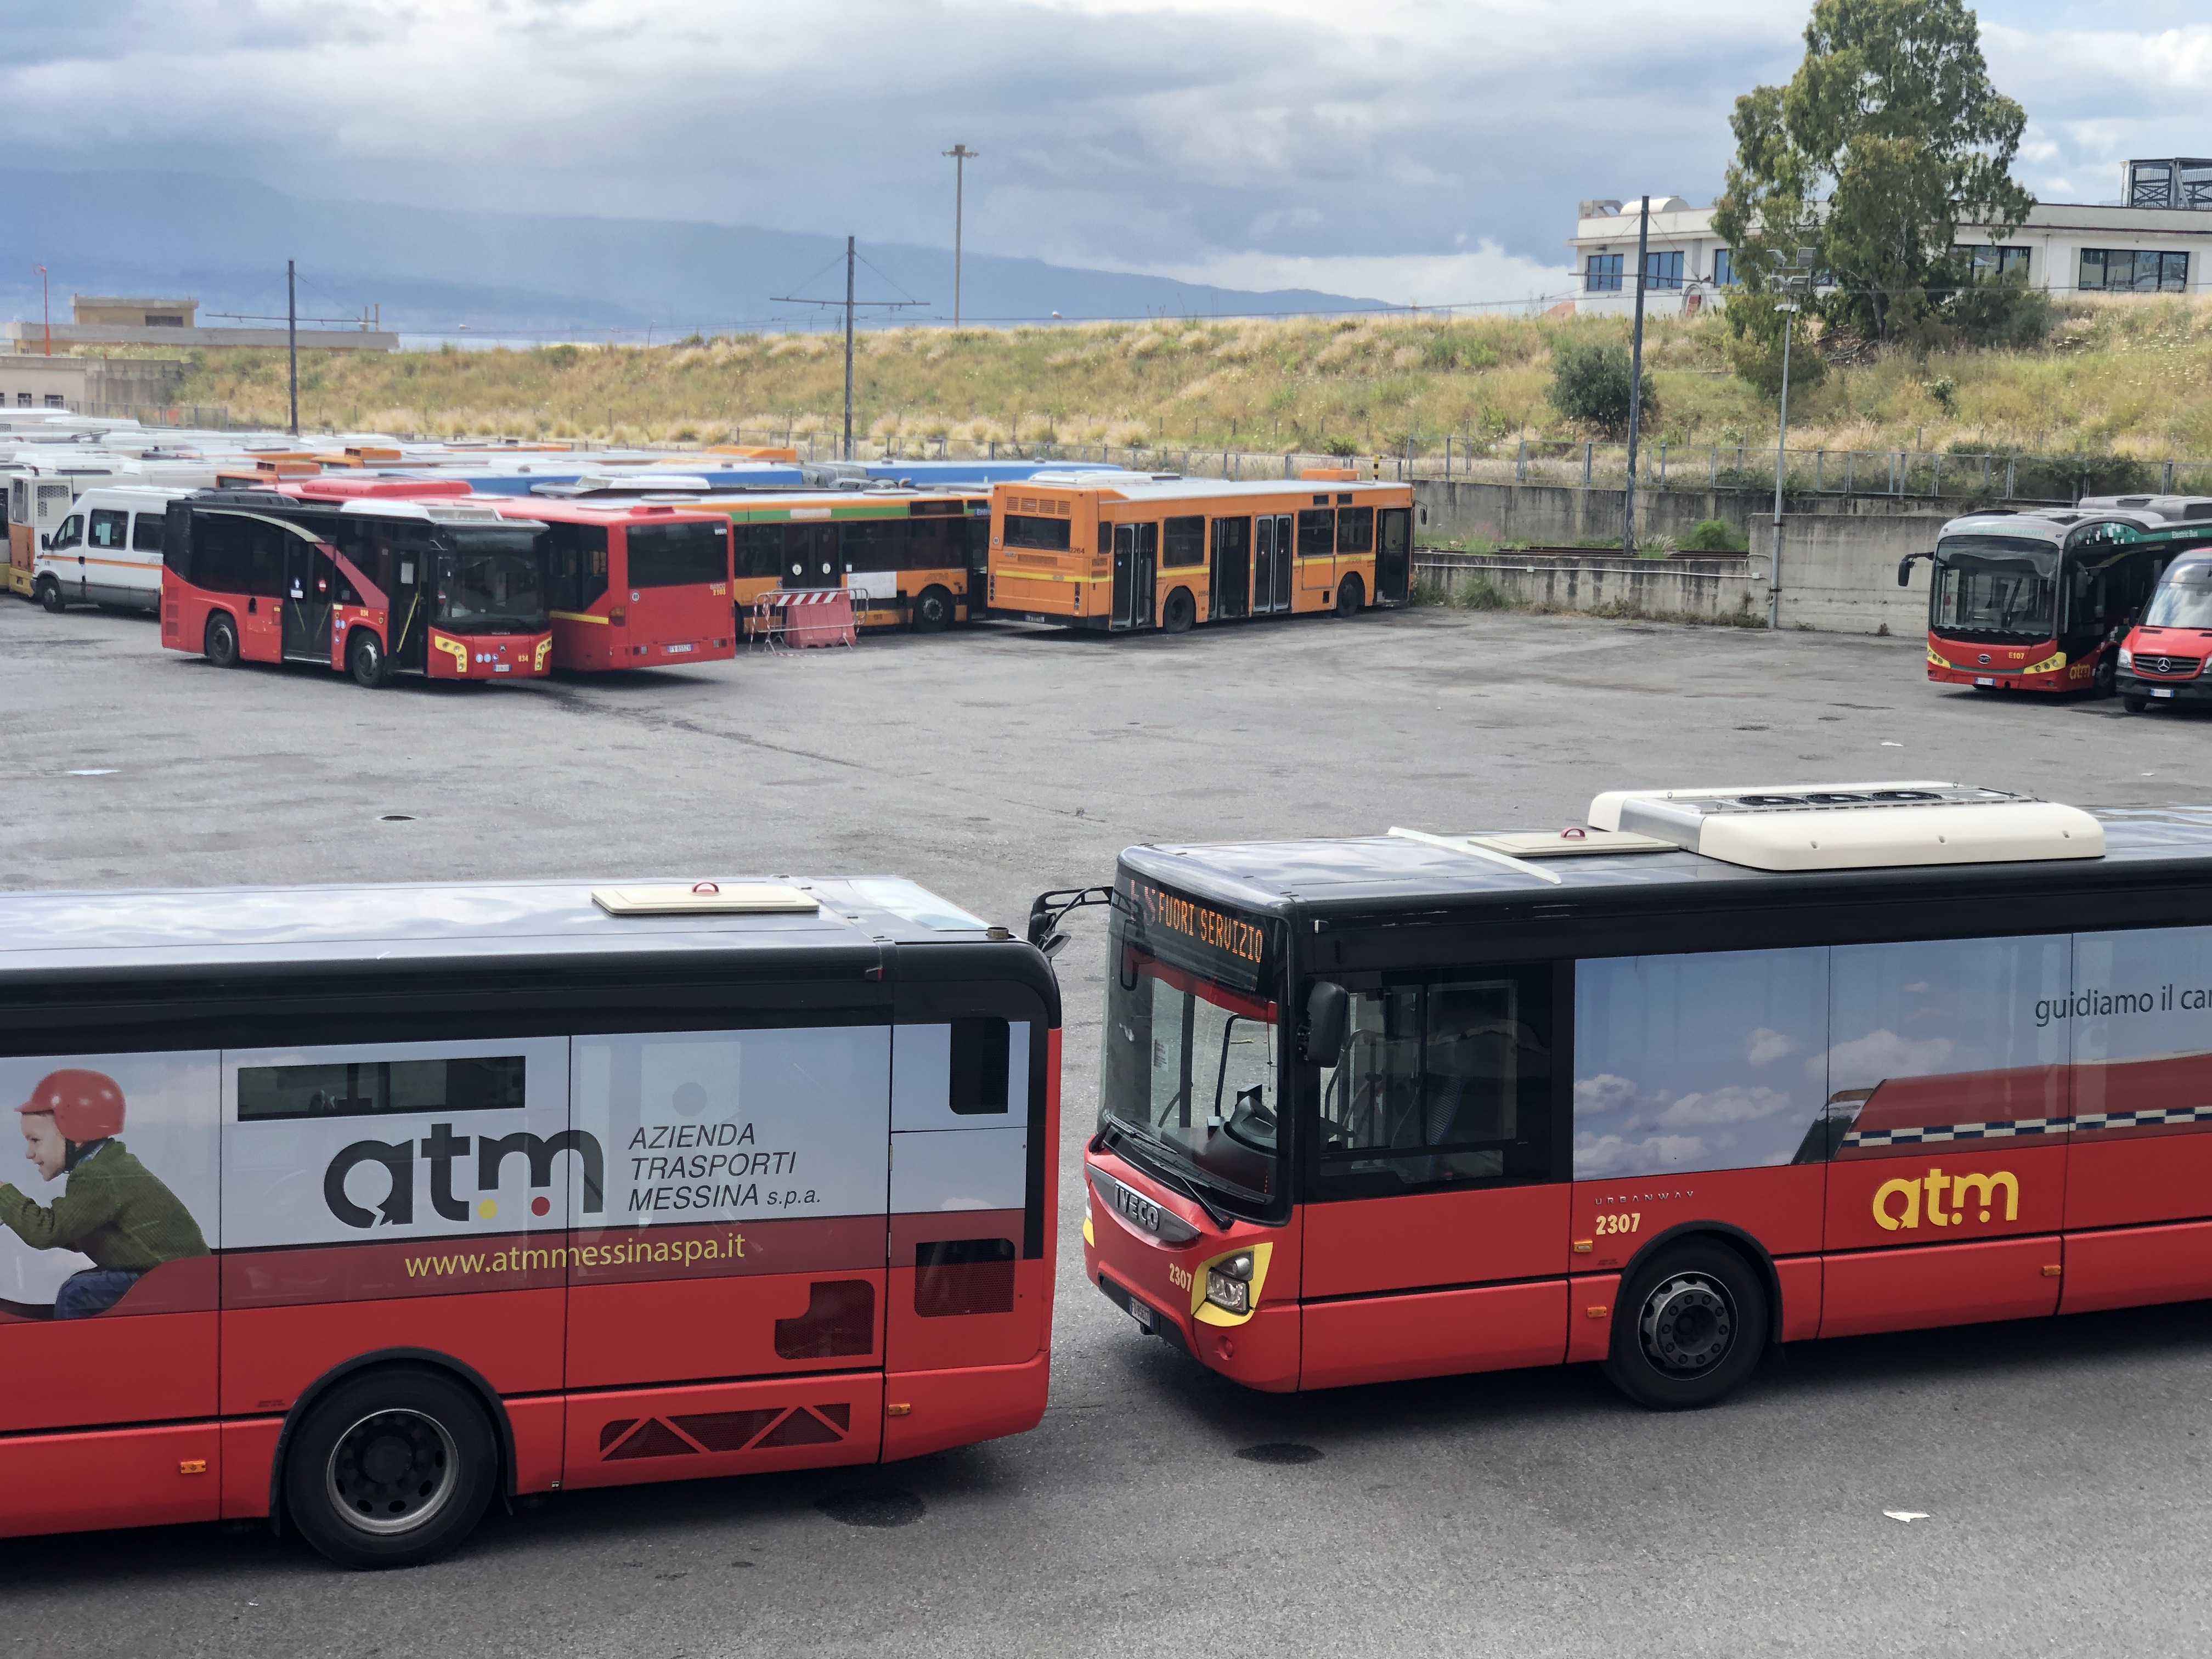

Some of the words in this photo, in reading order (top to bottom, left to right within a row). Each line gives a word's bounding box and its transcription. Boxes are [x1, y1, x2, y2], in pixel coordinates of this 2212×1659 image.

[2069, 664, 2091, 680] atm
[1159, 891, 1195, 936] FUORI
[1200, 909, 1263, 963] SERVIZIO
[2035, 989, 2154, 1028] guidiamo
[2161, 984, 2173, 1011] il
[628, 1122, 755, 1150] AZIENDA
[324, 1122, 603, 1229] atm
[631, 1151, 797, 1181] TRASPORTI
[628, 1183, 759, 1211] MESSINA
[766, 1189, 821, 1209] s.p.a.
[1114, 1184, 1159, 1231] IVECO
[1595, 1190, 1694, 1205] URBANWAY
[1872, 1168, 2019, 1231] atm
[1595, 1212, 1641, 1235] 2307
[405, 1232, 746, 1278] www.atmmessinaspa.it
[1169, 1262, 1192, 1293] 2307
